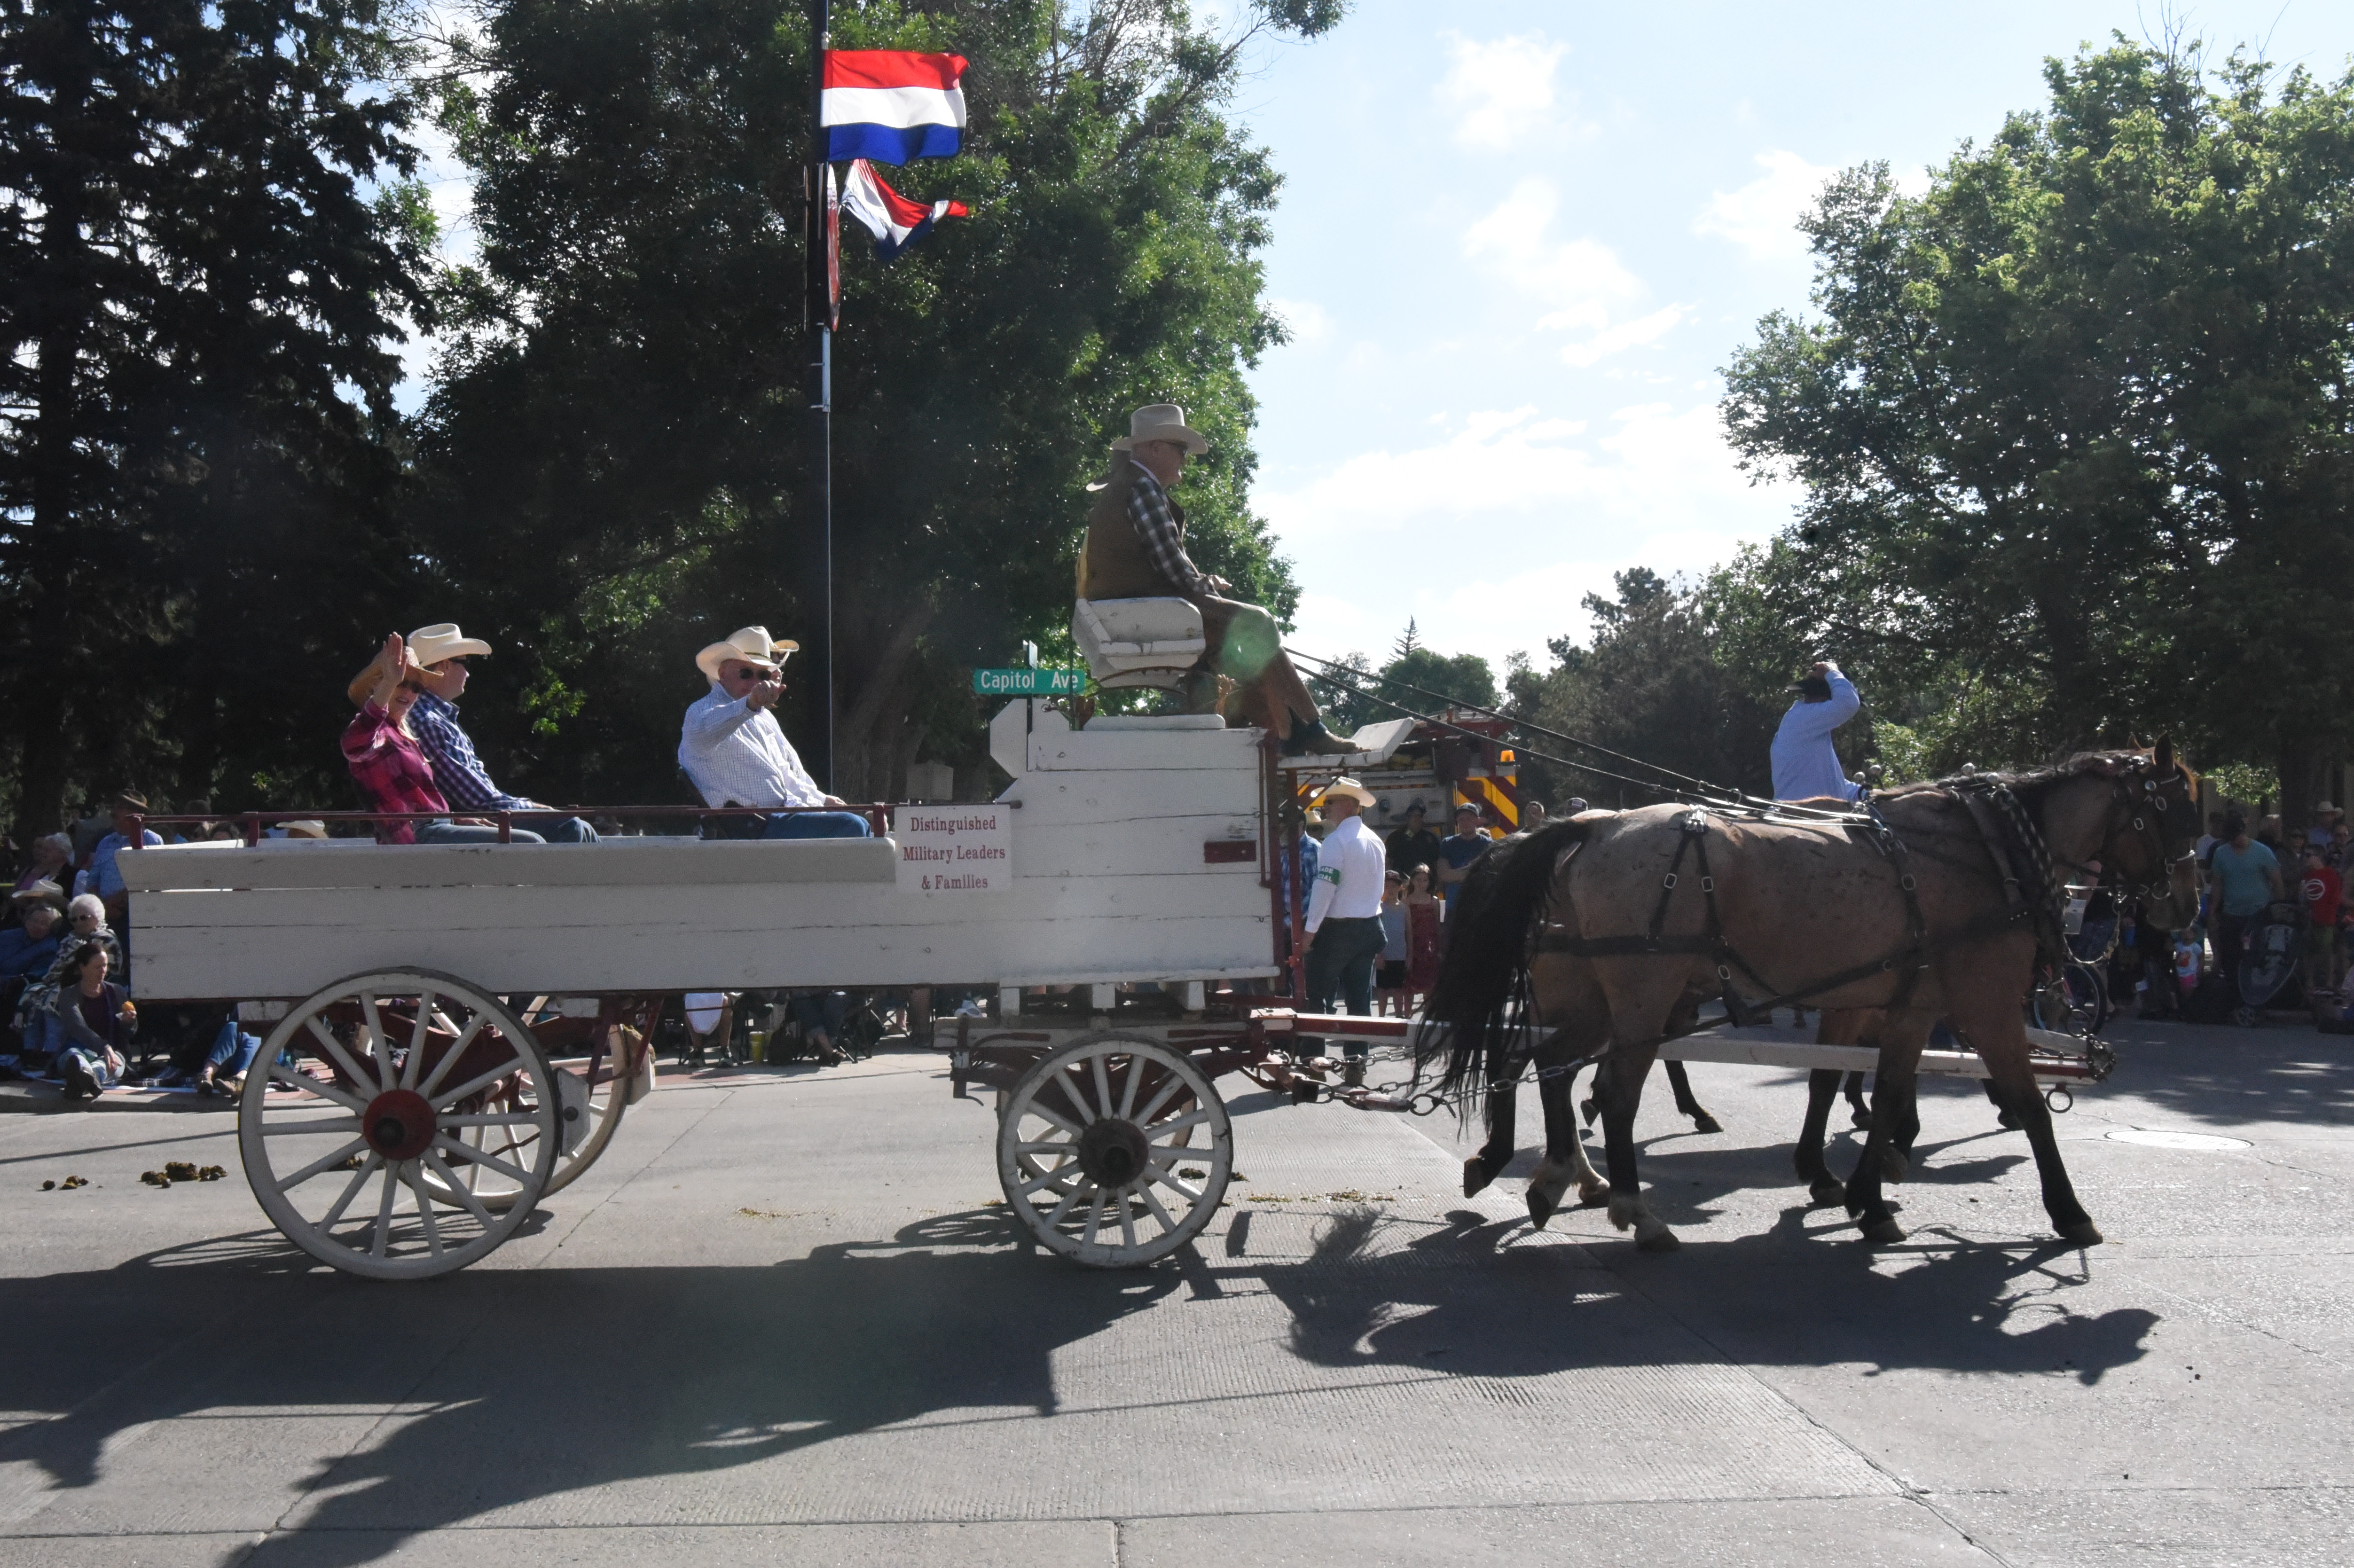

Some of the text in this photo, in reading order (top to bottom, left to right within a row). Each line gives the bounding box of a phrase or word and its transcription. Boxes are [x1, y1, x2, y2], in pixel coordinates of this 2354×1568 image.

[981, 671, 1078, 692] Capitol Ave
[910, 815, 996, 835] Distinguished
[903, 845, 1005, 864] Military Leaders
[921, 874, 988, 890] & Families
